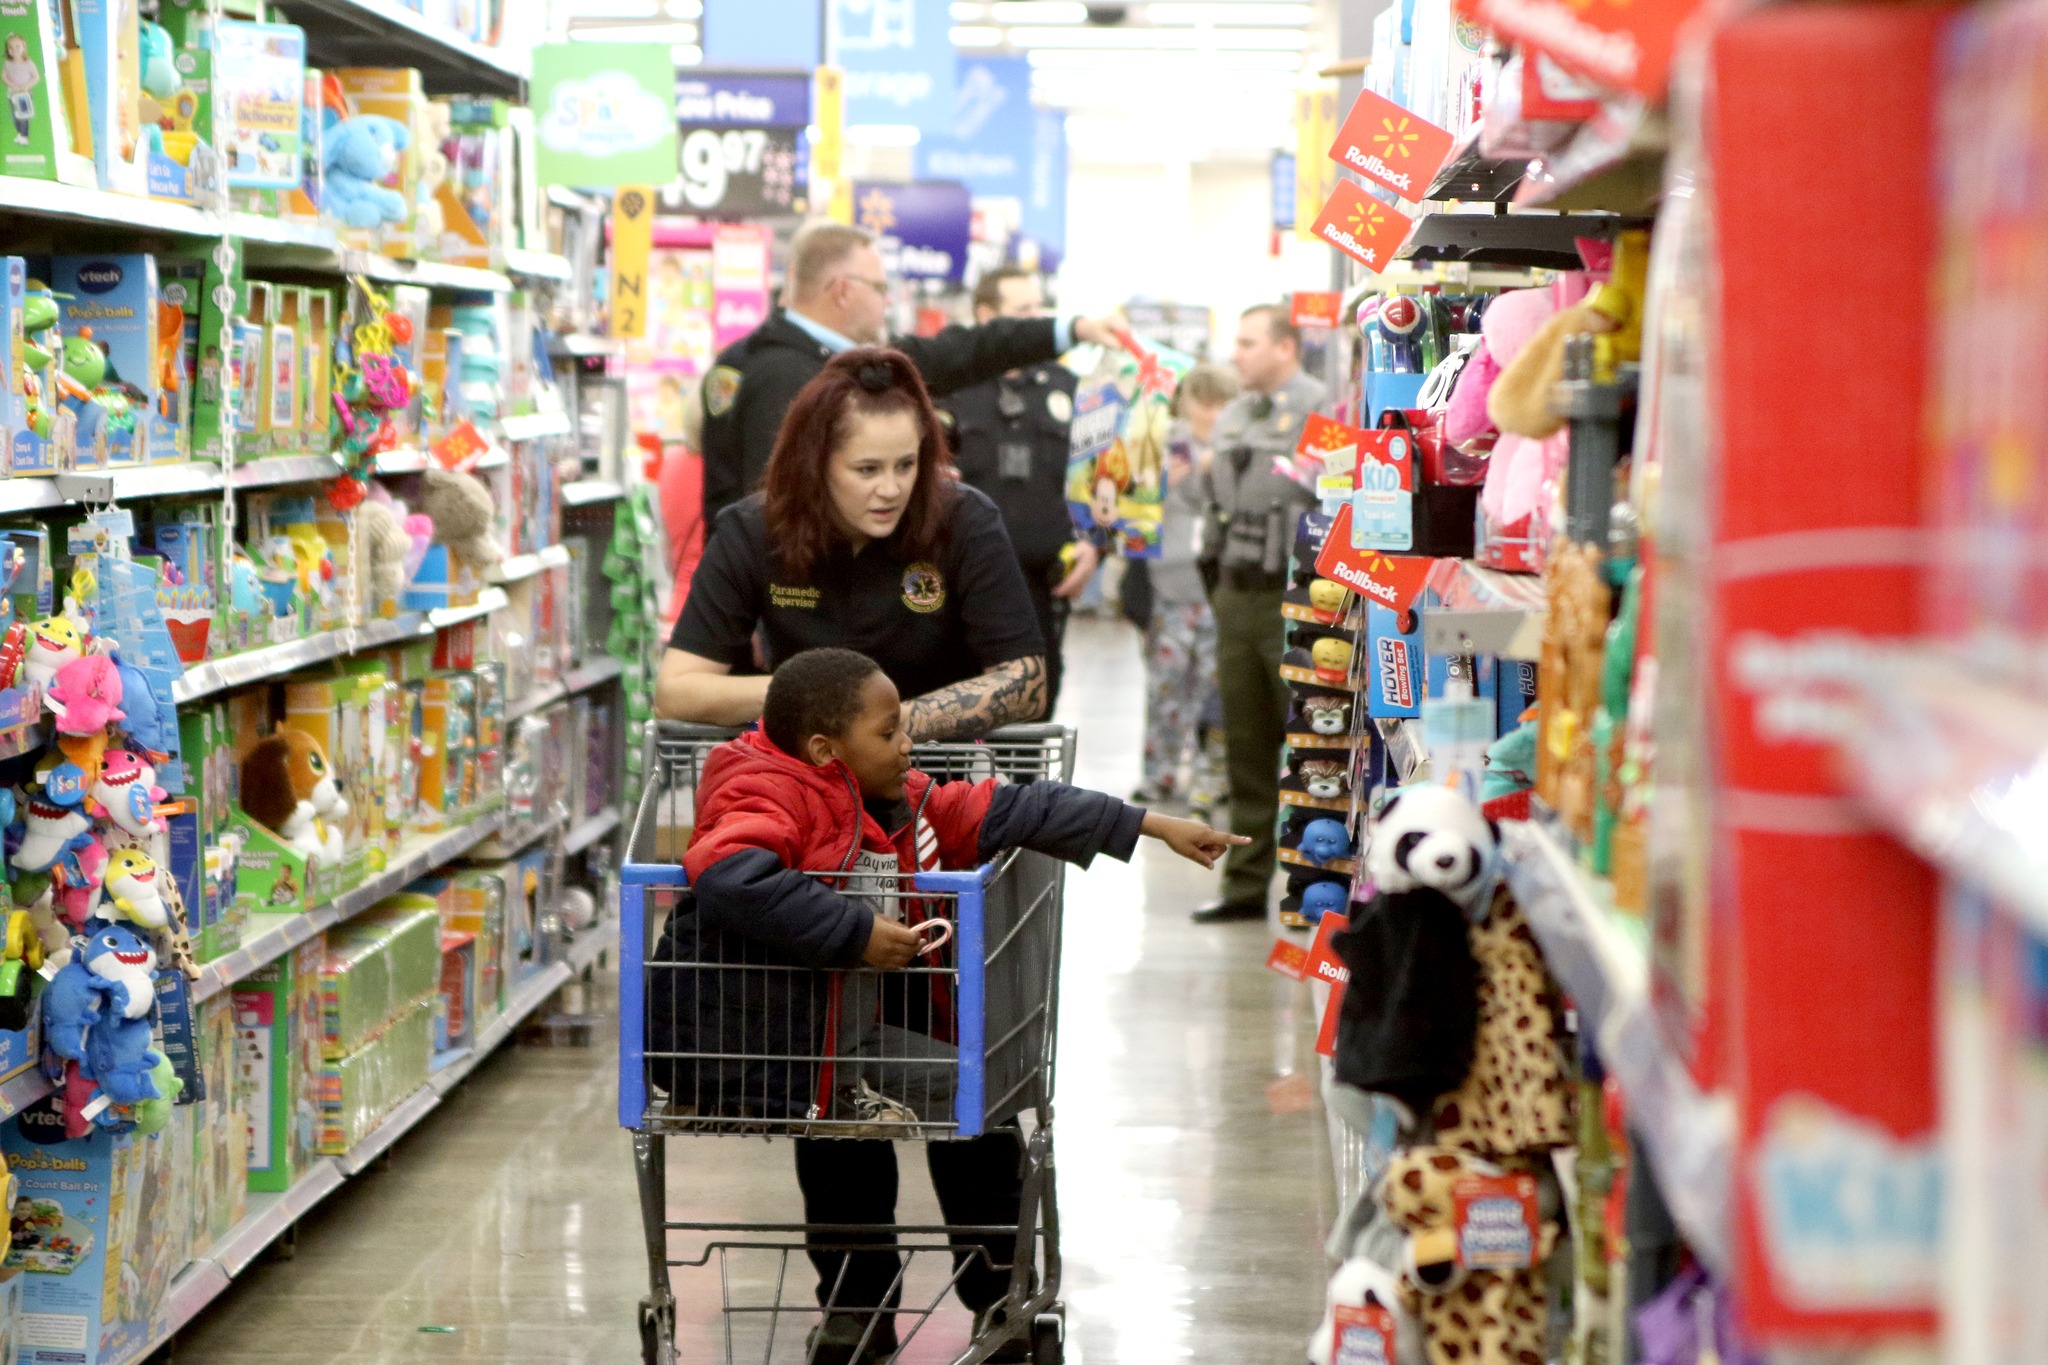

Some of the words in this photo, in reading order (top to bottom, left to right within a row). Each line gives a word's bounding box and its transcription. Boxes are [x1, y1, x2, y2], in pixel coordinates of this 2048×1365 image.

[1344, 145, 1413, 191] Rollback
[1323, 222, 1377, 264] Rollback
[79, 271, 120, 283] vtech
[1364, 465, 1399, 492] KID
[1308, 527, 1323, 536] LED
[770, 583, 821, 597] Paramedic
[1333, 561, 1399, 603] Rollback
[772, 596, 816, 608] Supervisor
[1397, 648, 1405, 664] Set
[1380, 638, 1399, 703] HOVER
[1398, 665, 1410, 700] Bowling
[854, 851, 897, 873] Zayvia
[1318, 960, 1350, 983] Roll
[22, 1111, 66, 1126] vtec
[25, 1179, 58, 1190] Count
[61, 1181, 81, 1191] Ball
[83, 1182, 98, 1193] Pit
